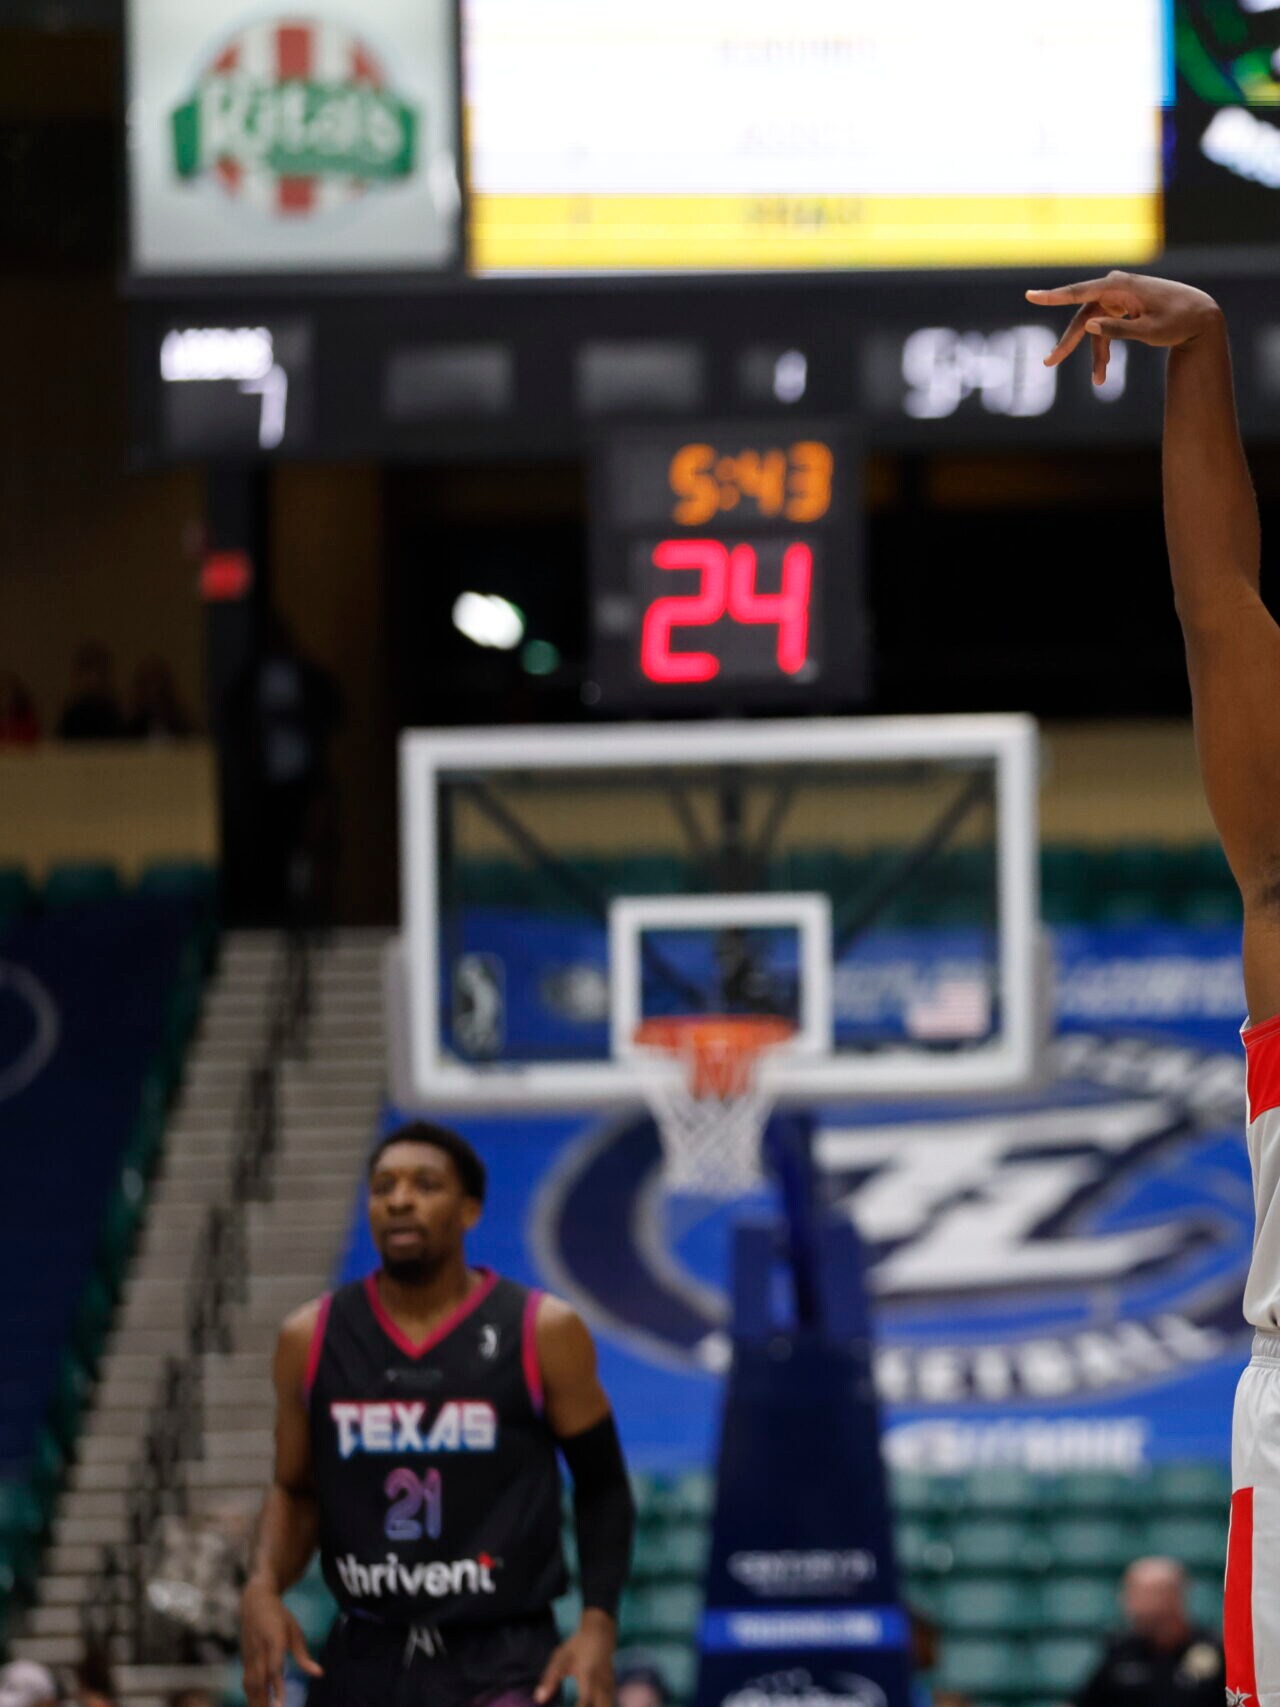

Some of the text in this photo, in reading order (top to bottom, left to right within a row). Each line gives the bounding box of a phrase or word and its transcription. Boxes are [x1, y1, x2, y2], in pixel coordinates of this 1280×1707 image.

[668, 440, 834, 526] 5:43
[641, 539, 813, 684] 24
[330, 1401, 498, 1460] TEXAS
[384, 1467, 443, 1541] 21
[336, 1553, 499, 1598] thrivent
